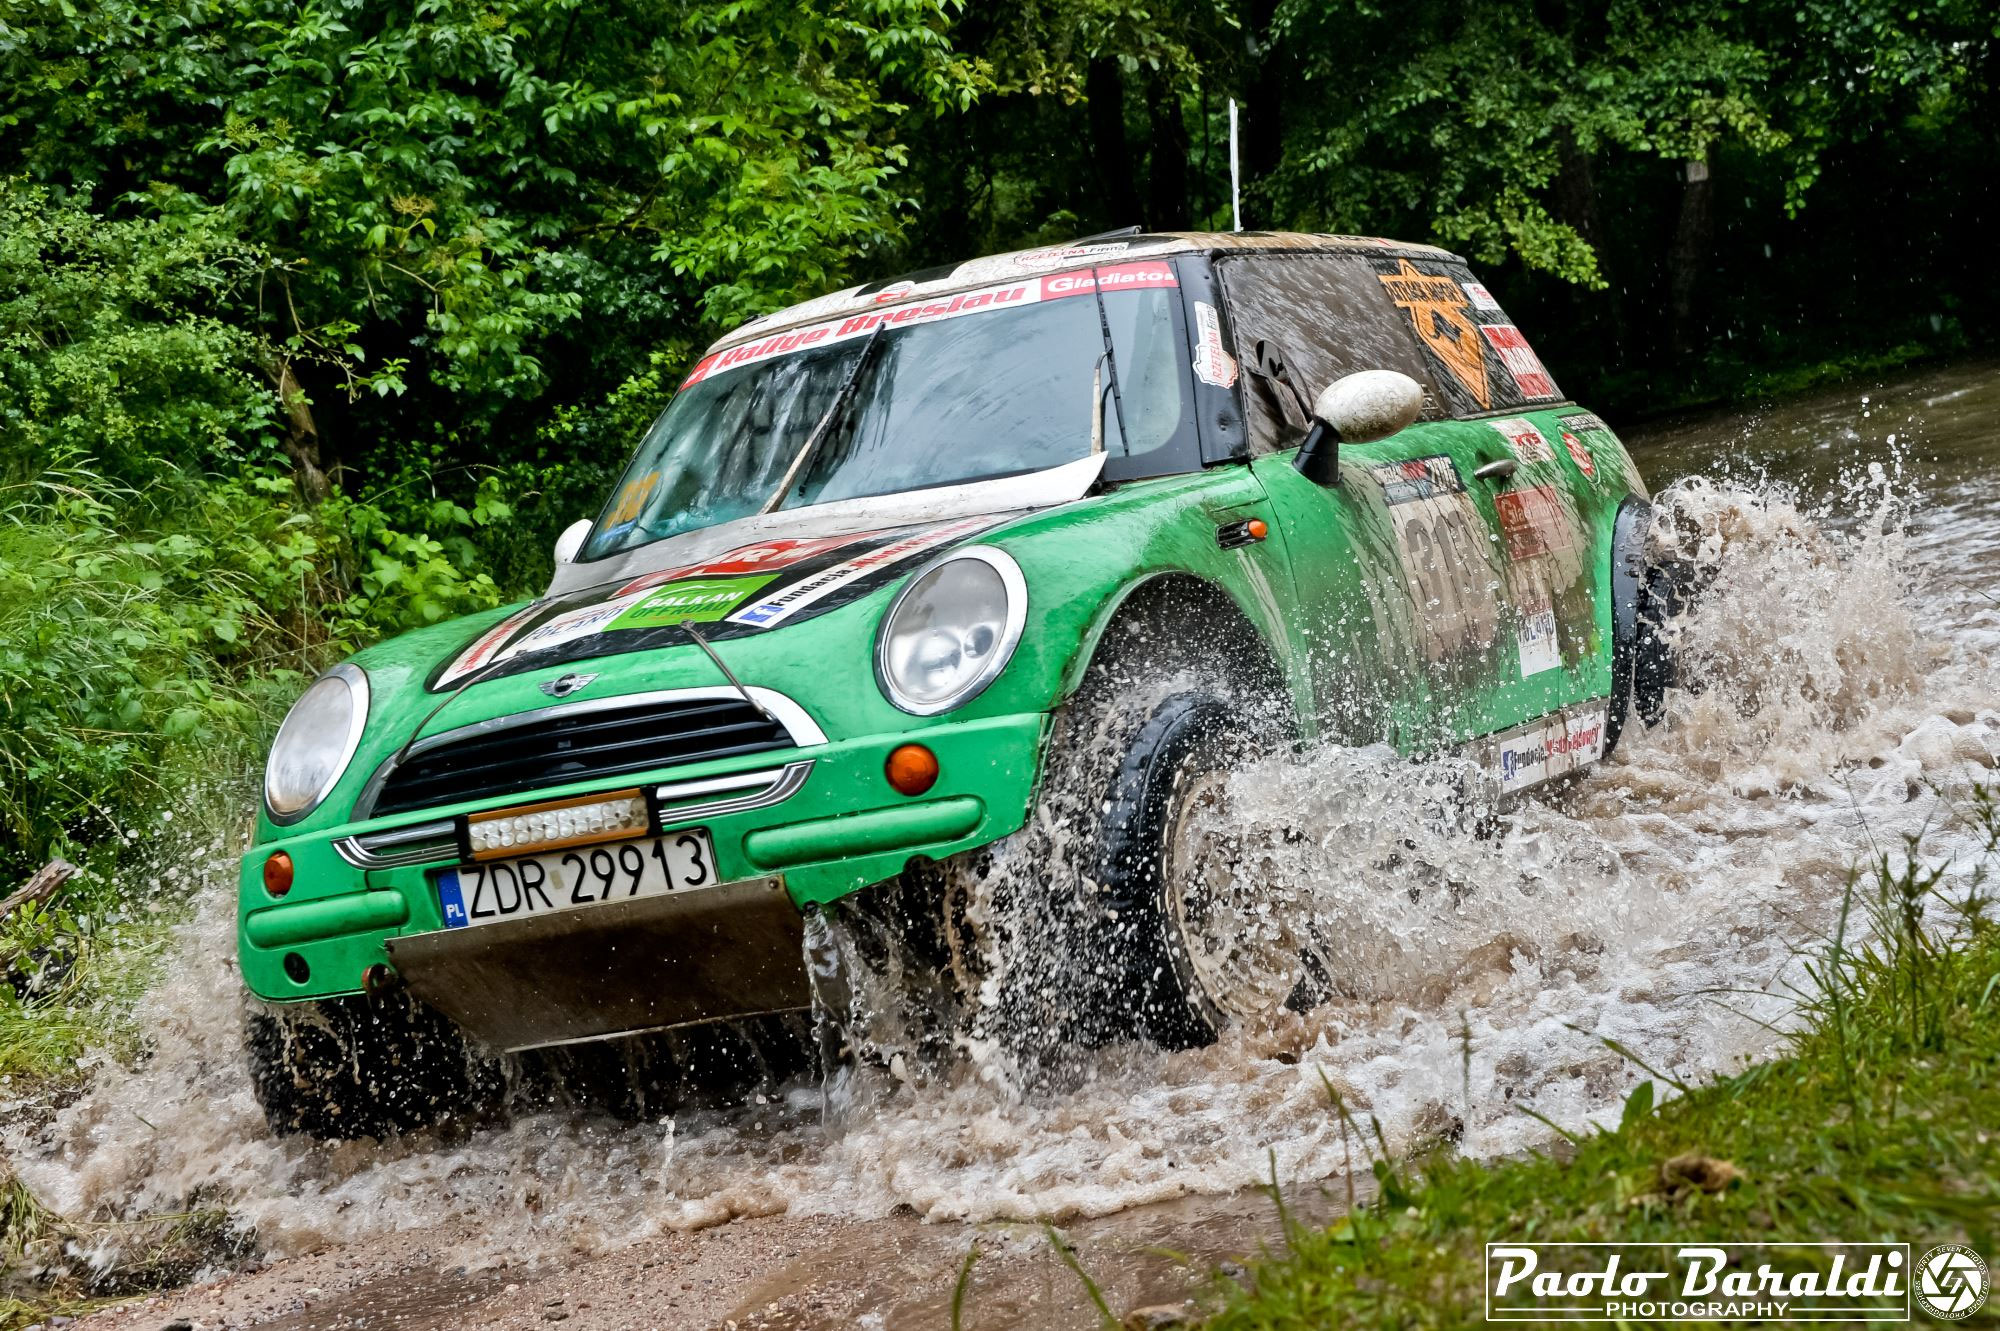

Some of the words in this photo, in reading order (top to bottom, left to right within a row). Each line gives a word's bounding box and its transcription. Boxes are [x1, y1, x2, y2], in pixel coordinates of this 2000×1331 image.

[716, 327, 831, 370] Rallye
[836, 287, 1026, 337] Breslau
[642, 591, 745, 609] BALKAN
[446, 904, 464, 919] PL
[461, 859, 554, 919] ZDR
[562, 835, 707, 905] 29913
